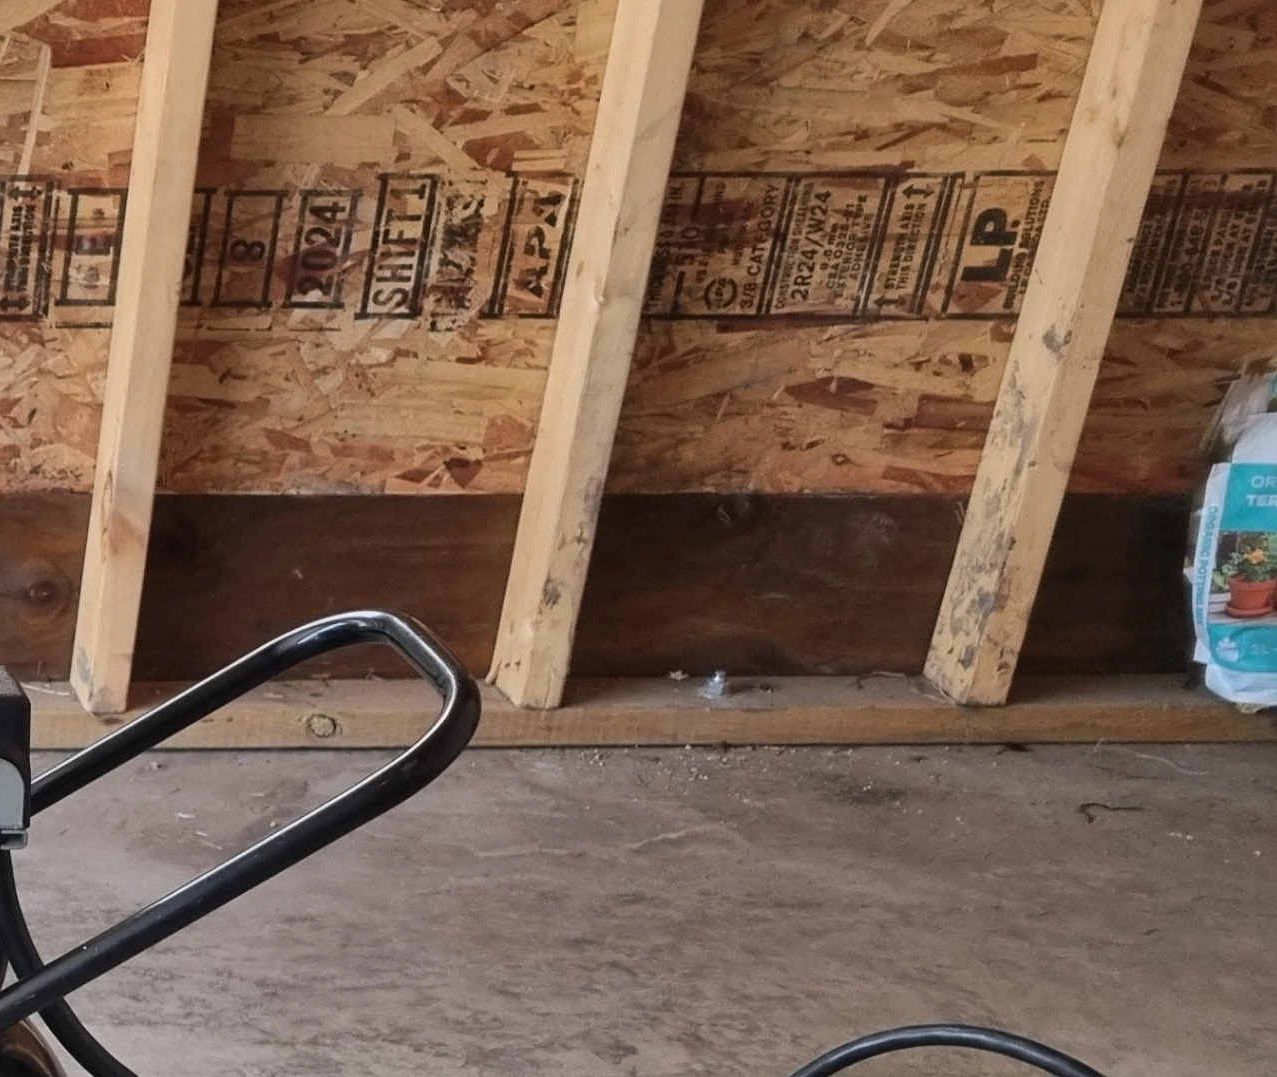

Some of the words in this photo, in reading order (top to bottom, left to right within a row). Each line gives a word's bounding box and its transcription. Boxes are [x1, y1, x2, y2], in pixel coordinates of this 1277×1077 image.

[390, 183, 427, 200] 1
[896, 203, 915, 230] AXIS
[230, 239, 265, 261] 8
[296, 202, 346, 296] 2024
[372, 208, 422, 309] SHIFT
[747, 183, 779, 276] CATEGORY
[790, 190, 833, 301] 2R24/W24
[902, 203, 927, 263] DIRECTION
[960, 207, 1018, 283] LP
[739, 281, 757, 309] 3/8
[896, 265, 911, 291] THIS
